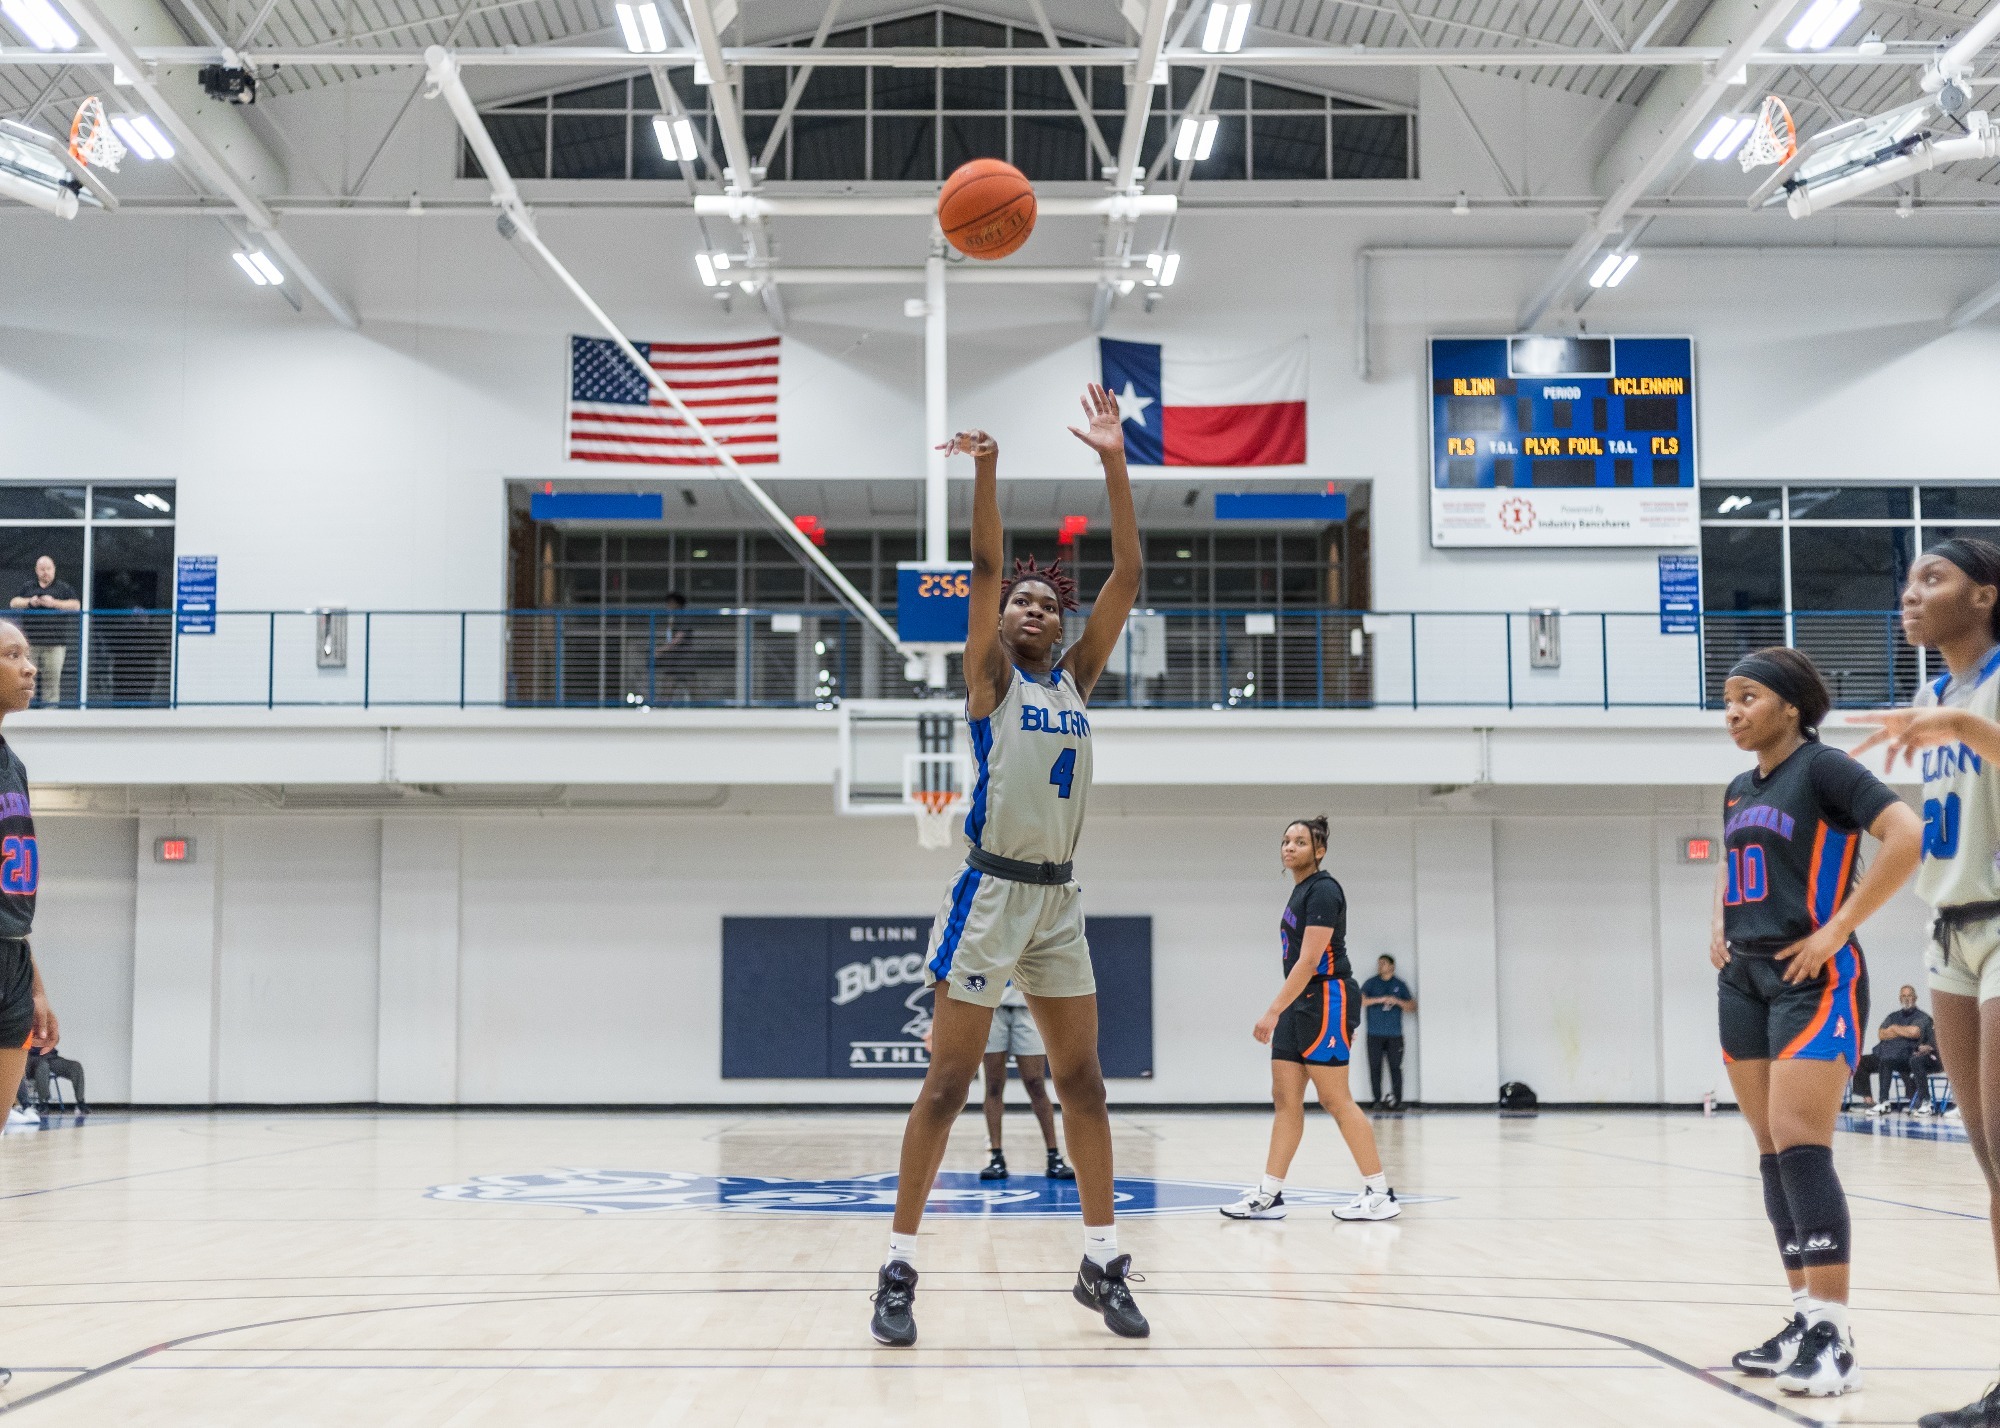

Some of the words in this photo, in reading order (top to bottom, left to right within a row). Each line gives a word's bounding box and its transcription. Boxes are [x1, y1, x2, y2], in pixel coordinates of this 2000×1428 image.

[1453, 378, 1496, 396] BLINN
[1543, 386, 1582, 400] PERIOD
[1613, 377, 1684, 395] MCLENNAN
[1447, 437, 1476, 455] FLS
[1489, 440, 1518, 454] T.O.L.
[1524, 437, 1560, 455] PLYR
[1568, 437, 1603, 455] FOUL
[1608, 440, 1638, 454] T.O.L.
[1651, 436, 1679, 455] FLS
[1538, 519, 1576, 530] Industry
[918, 574, 970, 598] 2:56
[1020, 704, 1092, 739] BLINN
[1049, 747, 1077, 799] 4
[0, 834, 39, 896] 20
[1723, 844, 1769, 906] 10
[850, 926, 918, 942] BLINN
[831, 951, 926, 1006] BUCC
[849, 1046, 931, 1063] ATHL
